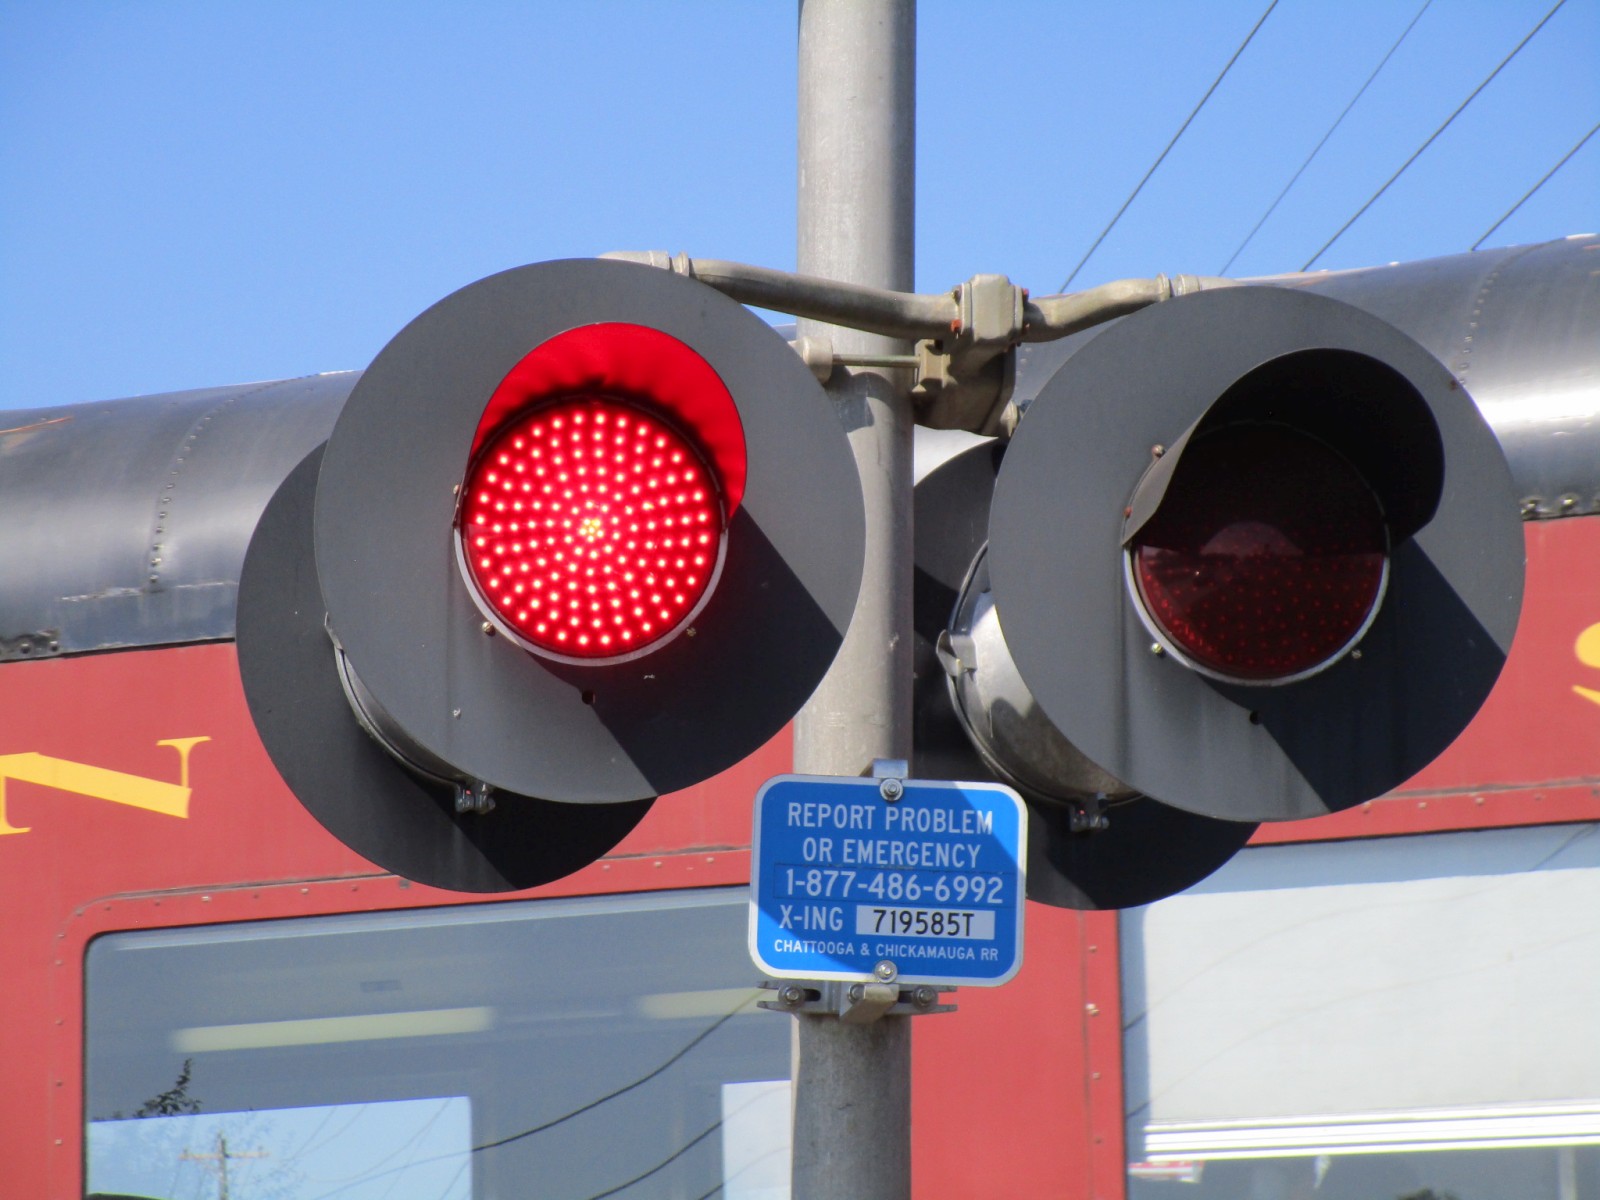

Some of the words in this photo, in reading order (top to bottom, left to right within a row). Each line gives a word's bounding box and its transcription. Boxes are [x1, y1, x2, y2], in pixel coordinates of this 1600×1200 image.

[787, 802, 876, 830] REPORT
[885, 806, 993, 835] PROBLEM
[803, 837, 833, 862] OR
[843, 839, 981, 868] EMERGENCY
[786, 868, 1003, 904] 1-877-486-6992
[779, 904, 844, 932] X-ING
[873, 909, 975, 937] 719585T
[774, 939, 855, 955] CHATTOOGA
[860, 943, 871, 956] &
[876, 944, 975, 961] CHICKAMAUGA
[981, 948, 999, 961] RR
